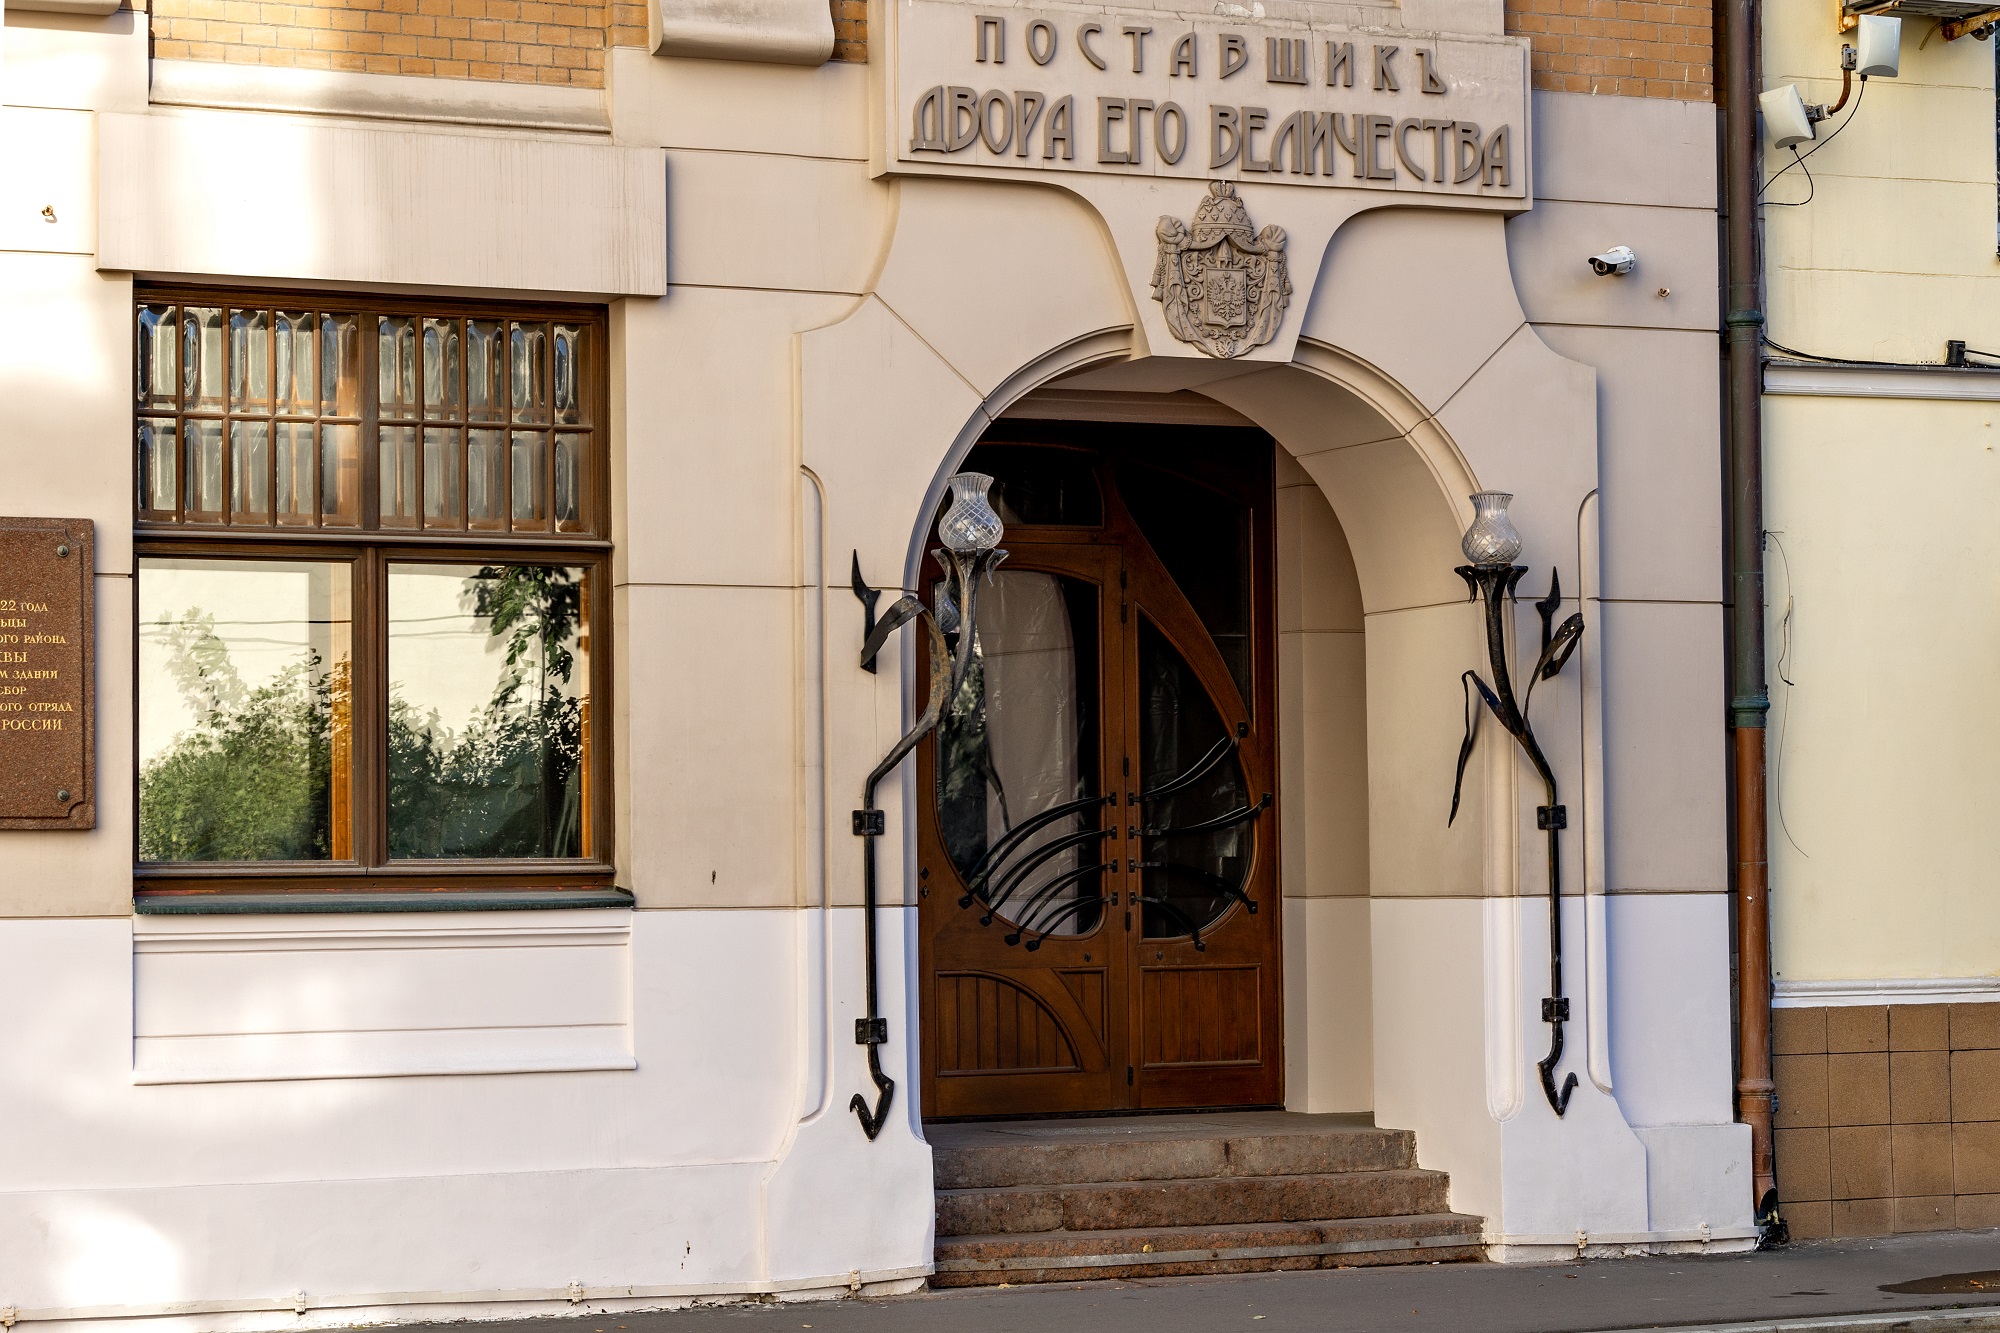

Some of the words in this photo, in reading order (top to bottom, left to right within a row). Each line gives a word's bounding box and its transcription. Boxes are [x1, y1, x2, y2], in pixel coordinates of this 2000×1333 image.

[975, 15, 1447, 93] ПОСТАВЩИКЪ
[909, 85, 1073, 159] ДВОРА
[1098, 97, 1187, 165] ЕГО
[1209, 104, 1511, 187] ВЕЛИЧЕСТВА
[21, 602, 48, 612] ГОДА
[24, 632, 66, 643] РАЙОНА
[13, 670, 58, 680] ЗДАНИИ
[29, 702, 73, 712] ОТРЯДА
[2, 719, 62, 730] РОССИИ
